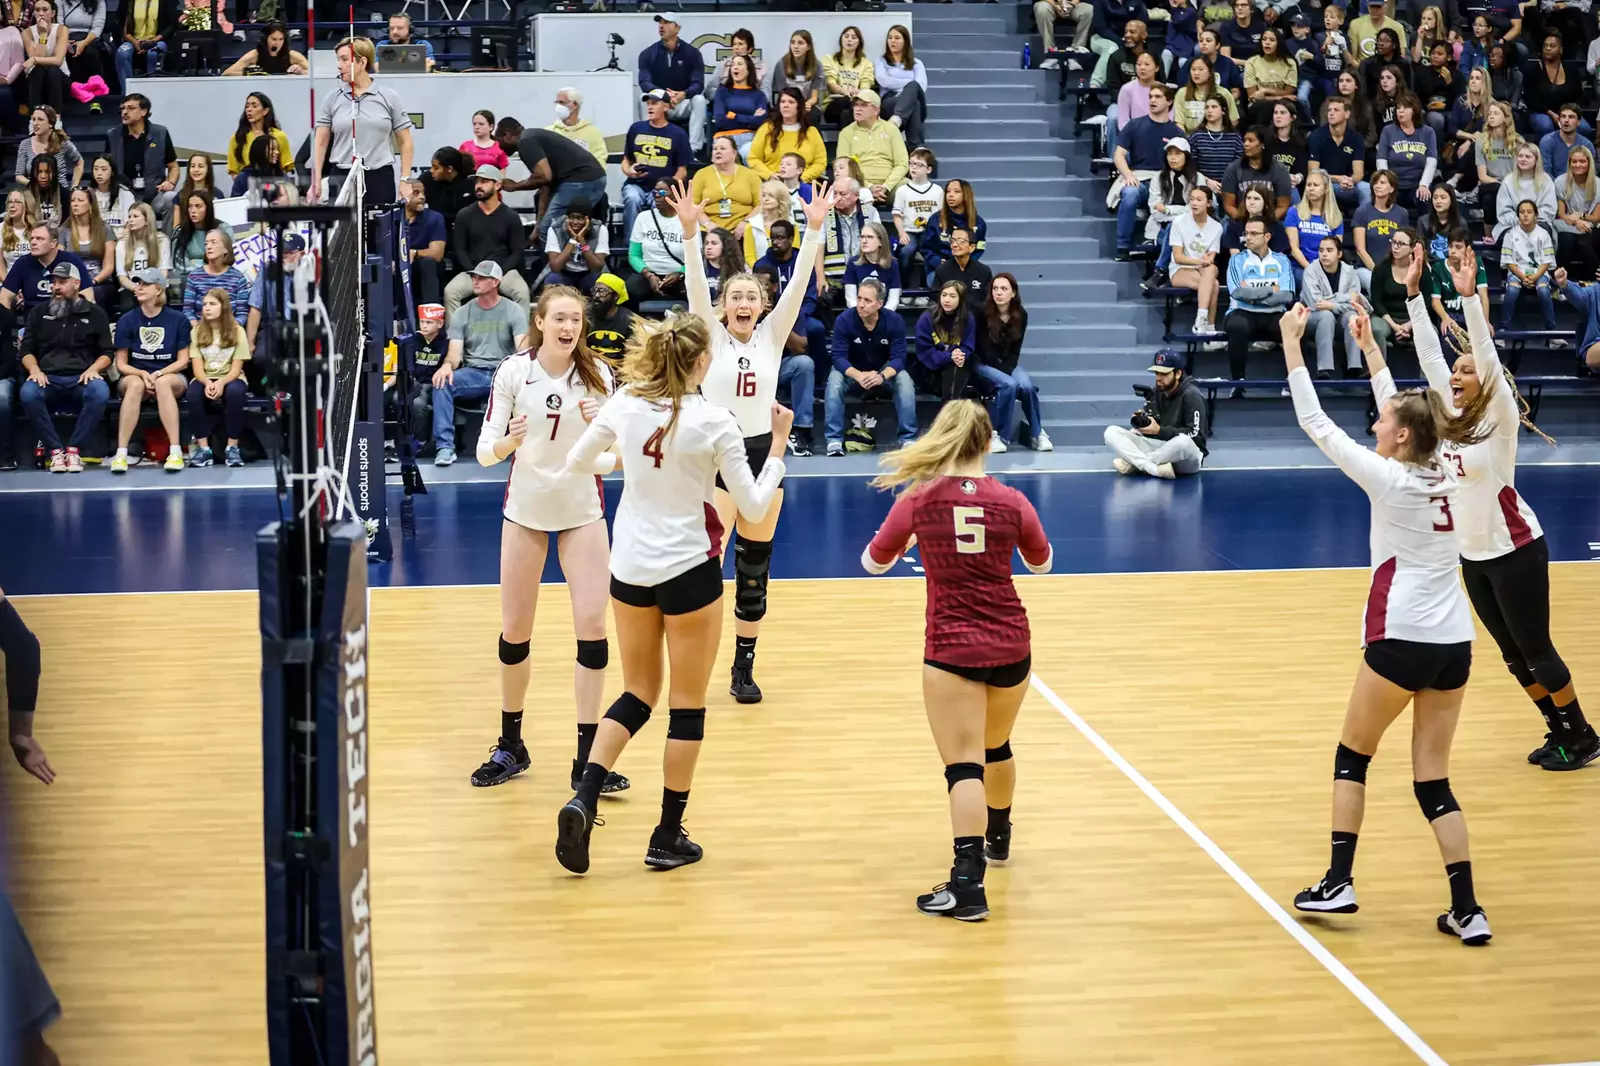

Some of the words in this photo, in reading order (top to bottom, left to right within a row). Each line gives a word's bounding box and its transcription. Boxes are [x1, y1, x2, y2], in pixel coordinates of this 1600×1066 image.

[1298, 221, 1311, 230] AIR
[736, 372, 756, 397] 16
[546, 414, 562, 441] 7
[358, 438, 369, 470] sports
[643, 427, 664, 468] 4
[358, 471, 369, 511] imports
[953, 506, 985, 553] 5
[1429, 496, 1454, 532] 3
[344, 625, 369, 848] TECH
